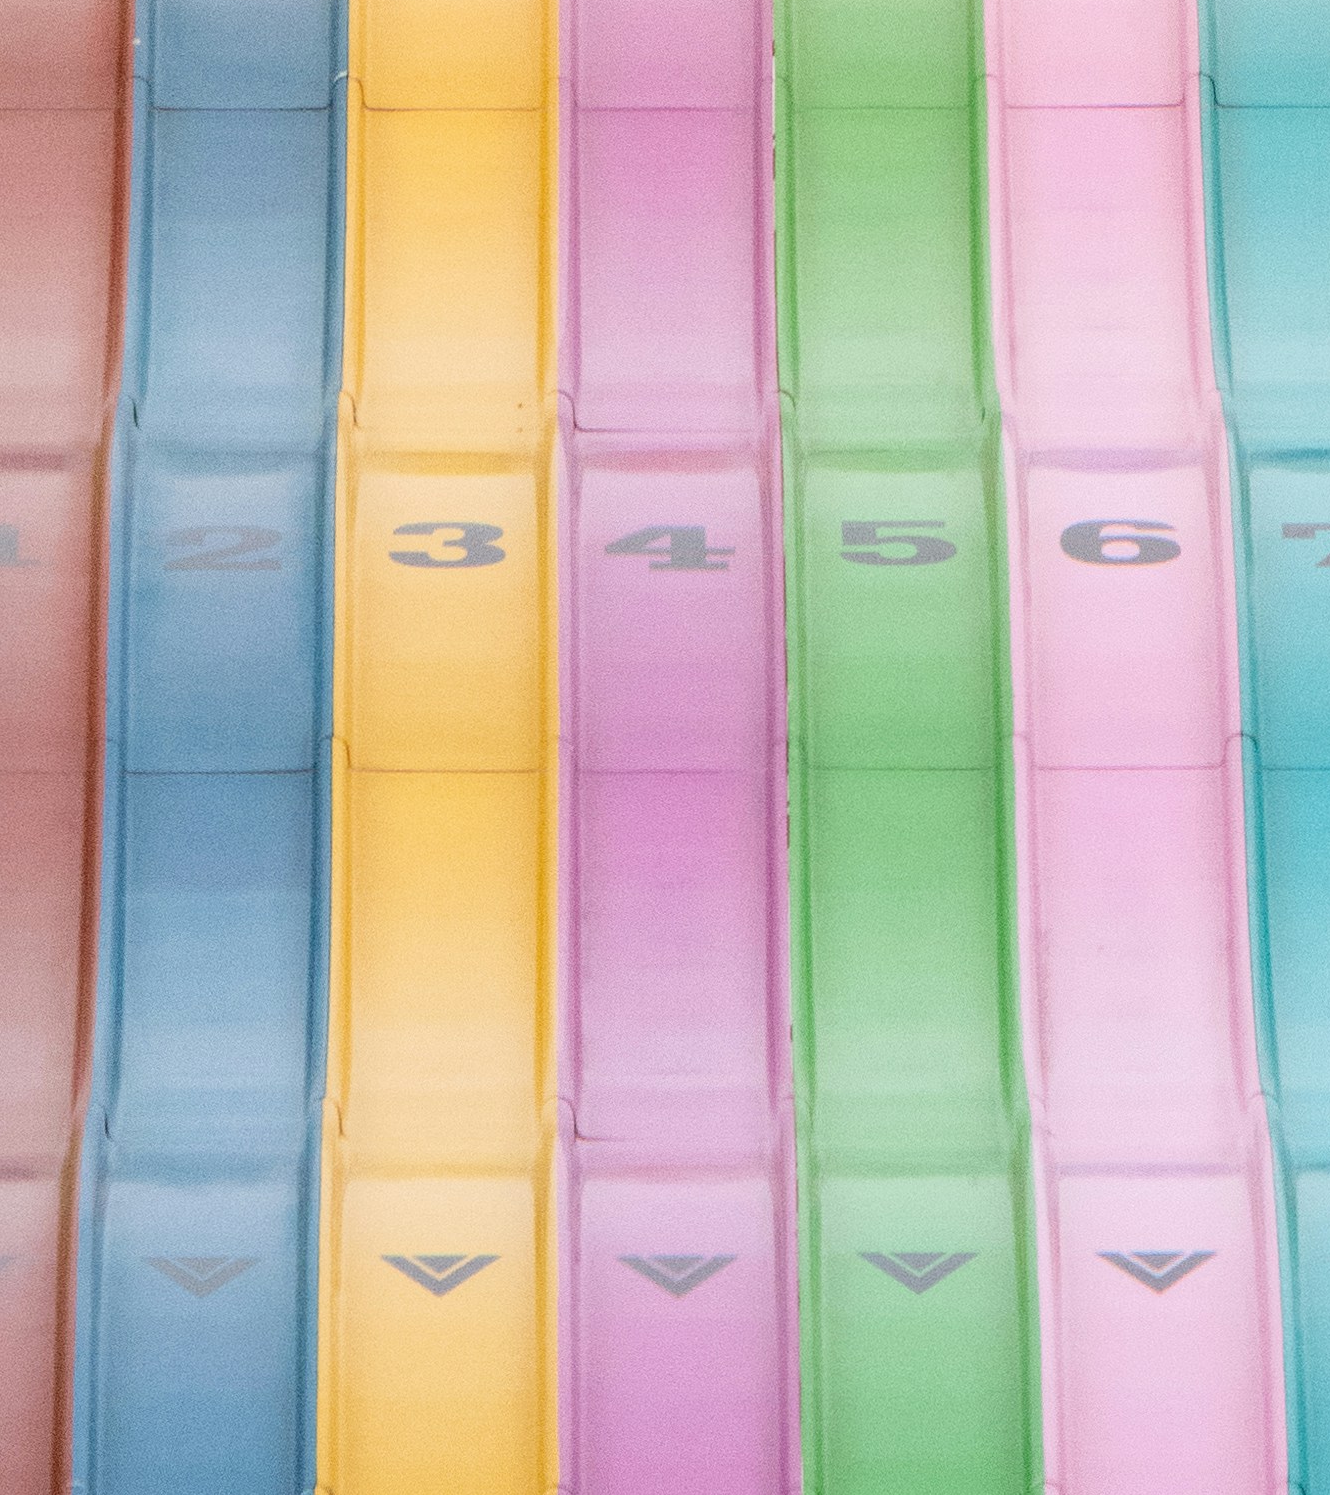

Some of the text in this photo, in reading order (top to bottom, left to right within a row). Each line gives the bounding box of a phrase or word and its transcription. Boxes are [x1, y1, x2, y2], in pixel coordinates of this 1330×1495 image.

[163, 524, 282, 571] 2
[388, 521, 507, 570] 3
[604, 524, 736, 571] 4
[839, 519, 958, 567] 5
[1059, 517, 1182, 566] 6
